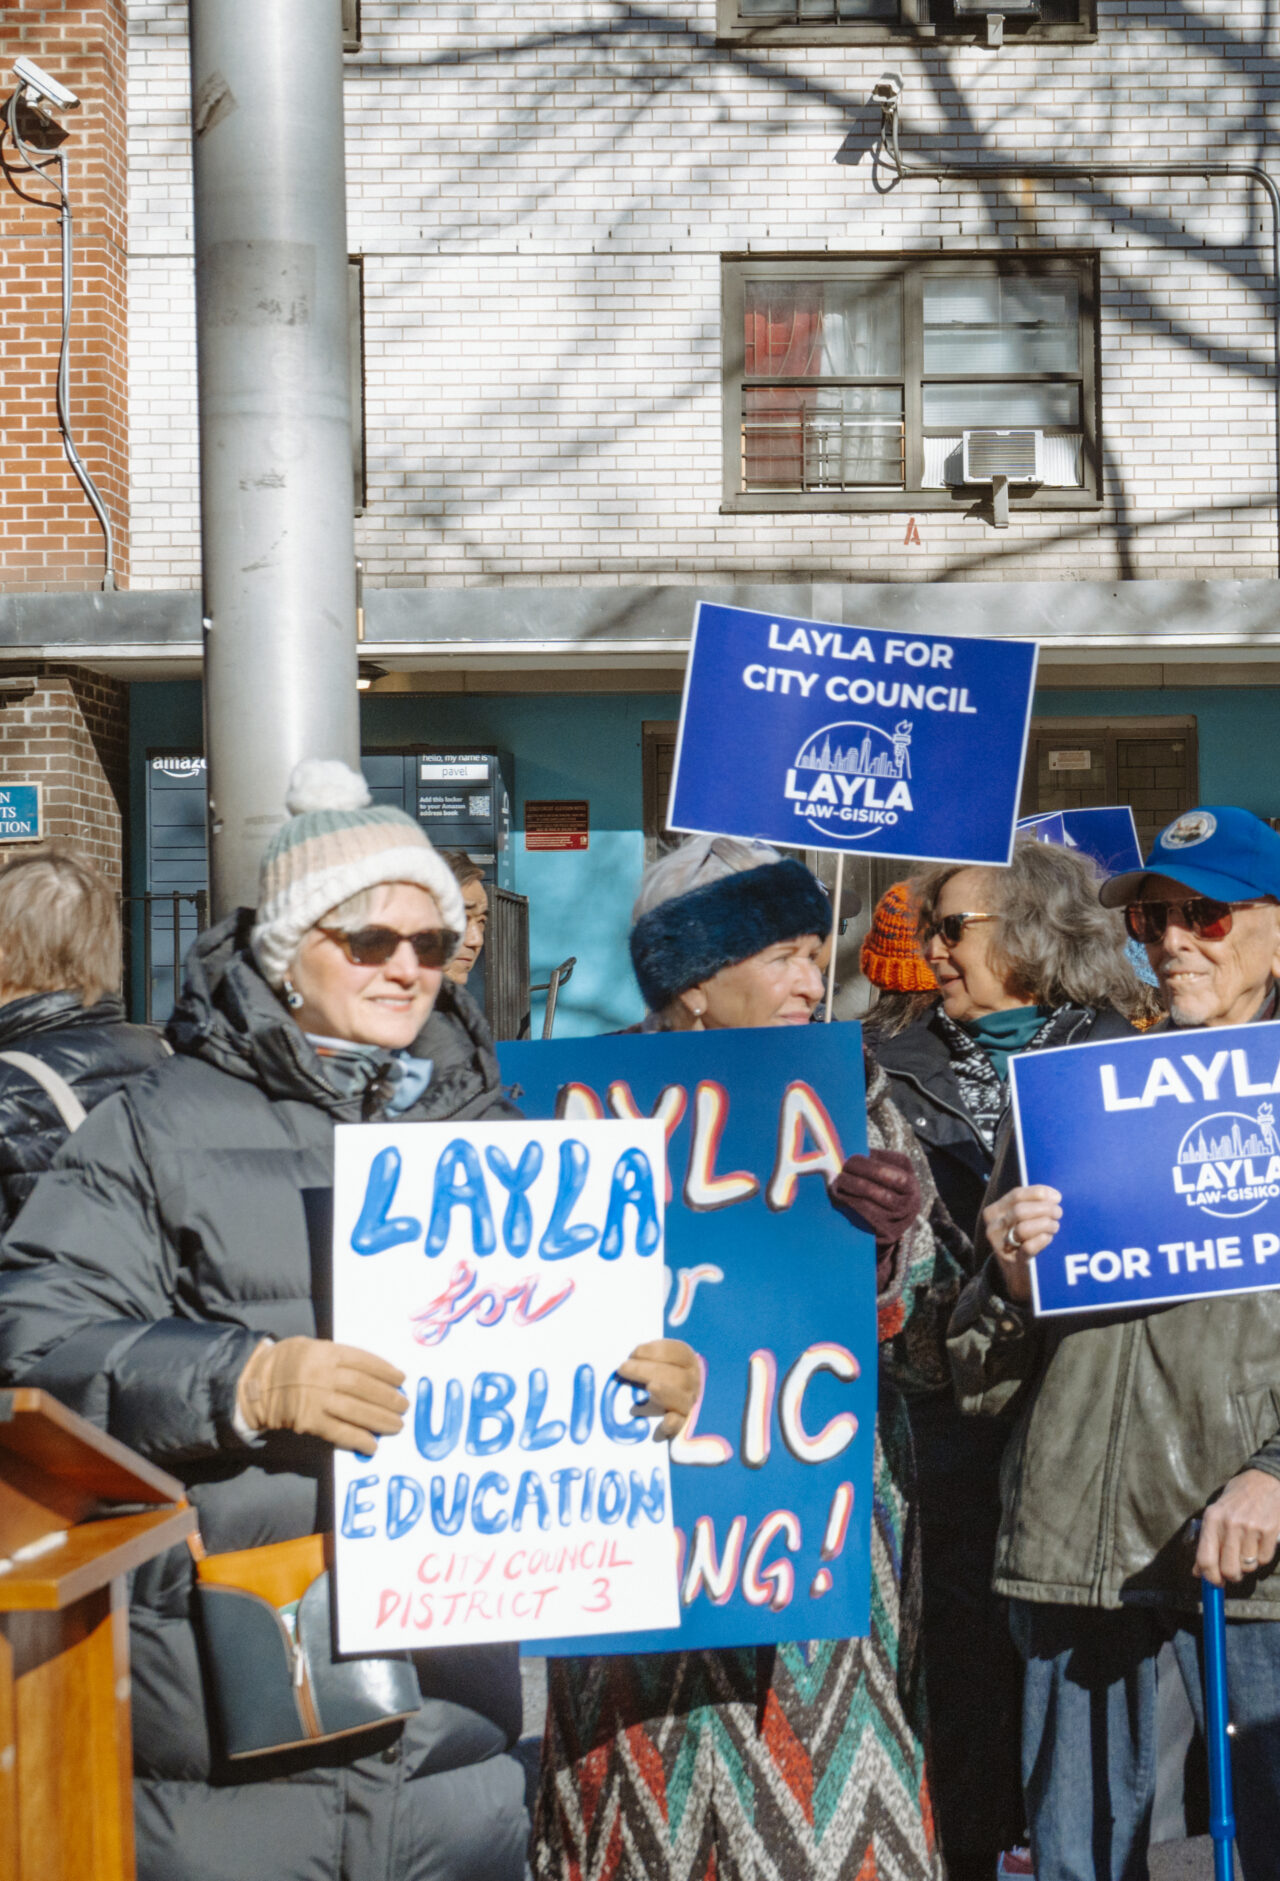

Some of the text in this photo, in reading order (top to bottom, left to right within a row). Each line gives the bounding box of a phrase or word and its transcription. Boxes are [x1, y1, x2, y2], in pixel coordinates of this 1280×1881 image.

[903, 516, 921, 546] A
[768, 624, 954, 669] LAYLA FOR
[742, 664, 977, 713] CITY COUNCIL
[441, 766, 468, 778] pavel
[784, 768, 914, 812] LAYLA
[794, 802, 898, 825] LAW-GISIKO
[350, 1137, 661, 1262] LAYLA
[1186, 1184, 1280, 1206] LAW-GISIKO
[1065, 1247, 1152, 1286] FOR
[1158, 1236, 1243, 1275] THE
[409, 1259, 576, 1347] for
[354, 1363, 652, 1463] UBLIC
[340, 1466, 666, 1540] EDUCATION
[416, 1539, 634, 1586] CITY COUNCIL
[673, 1481, 855, 1613] NG!
[374, 1577, 614, 1631] DISTRICT 3
